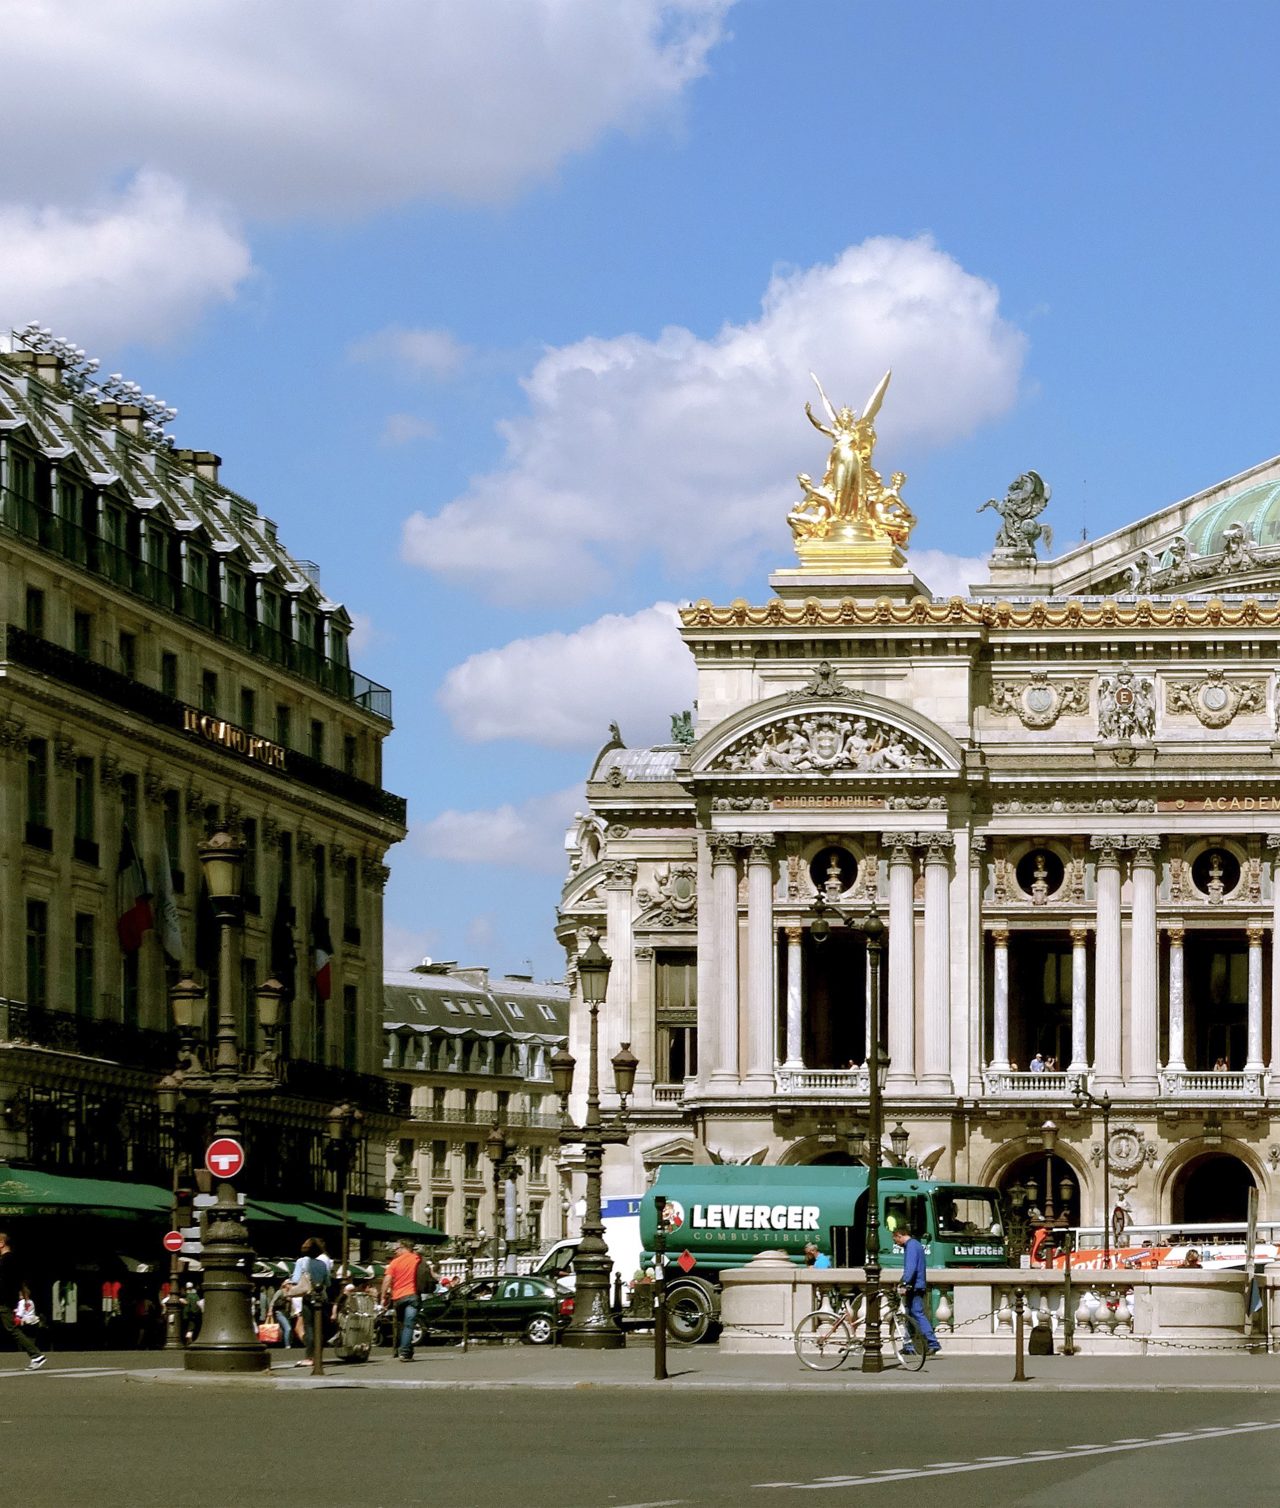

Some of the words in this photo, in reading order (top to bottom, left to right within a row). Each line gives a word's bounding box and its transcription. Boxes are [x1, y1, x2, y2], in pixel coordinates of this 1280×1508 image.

[200, 715, 247, 753] GRAND
[783, 795, 874, 807] CHOREGRAPHIE
[692, 1204, 820, 1230] LEVERGER
[693, 1232, 821, 1242] COMBUSTIBLES
[954, 1246, 1004, 1256] LEVERGER
